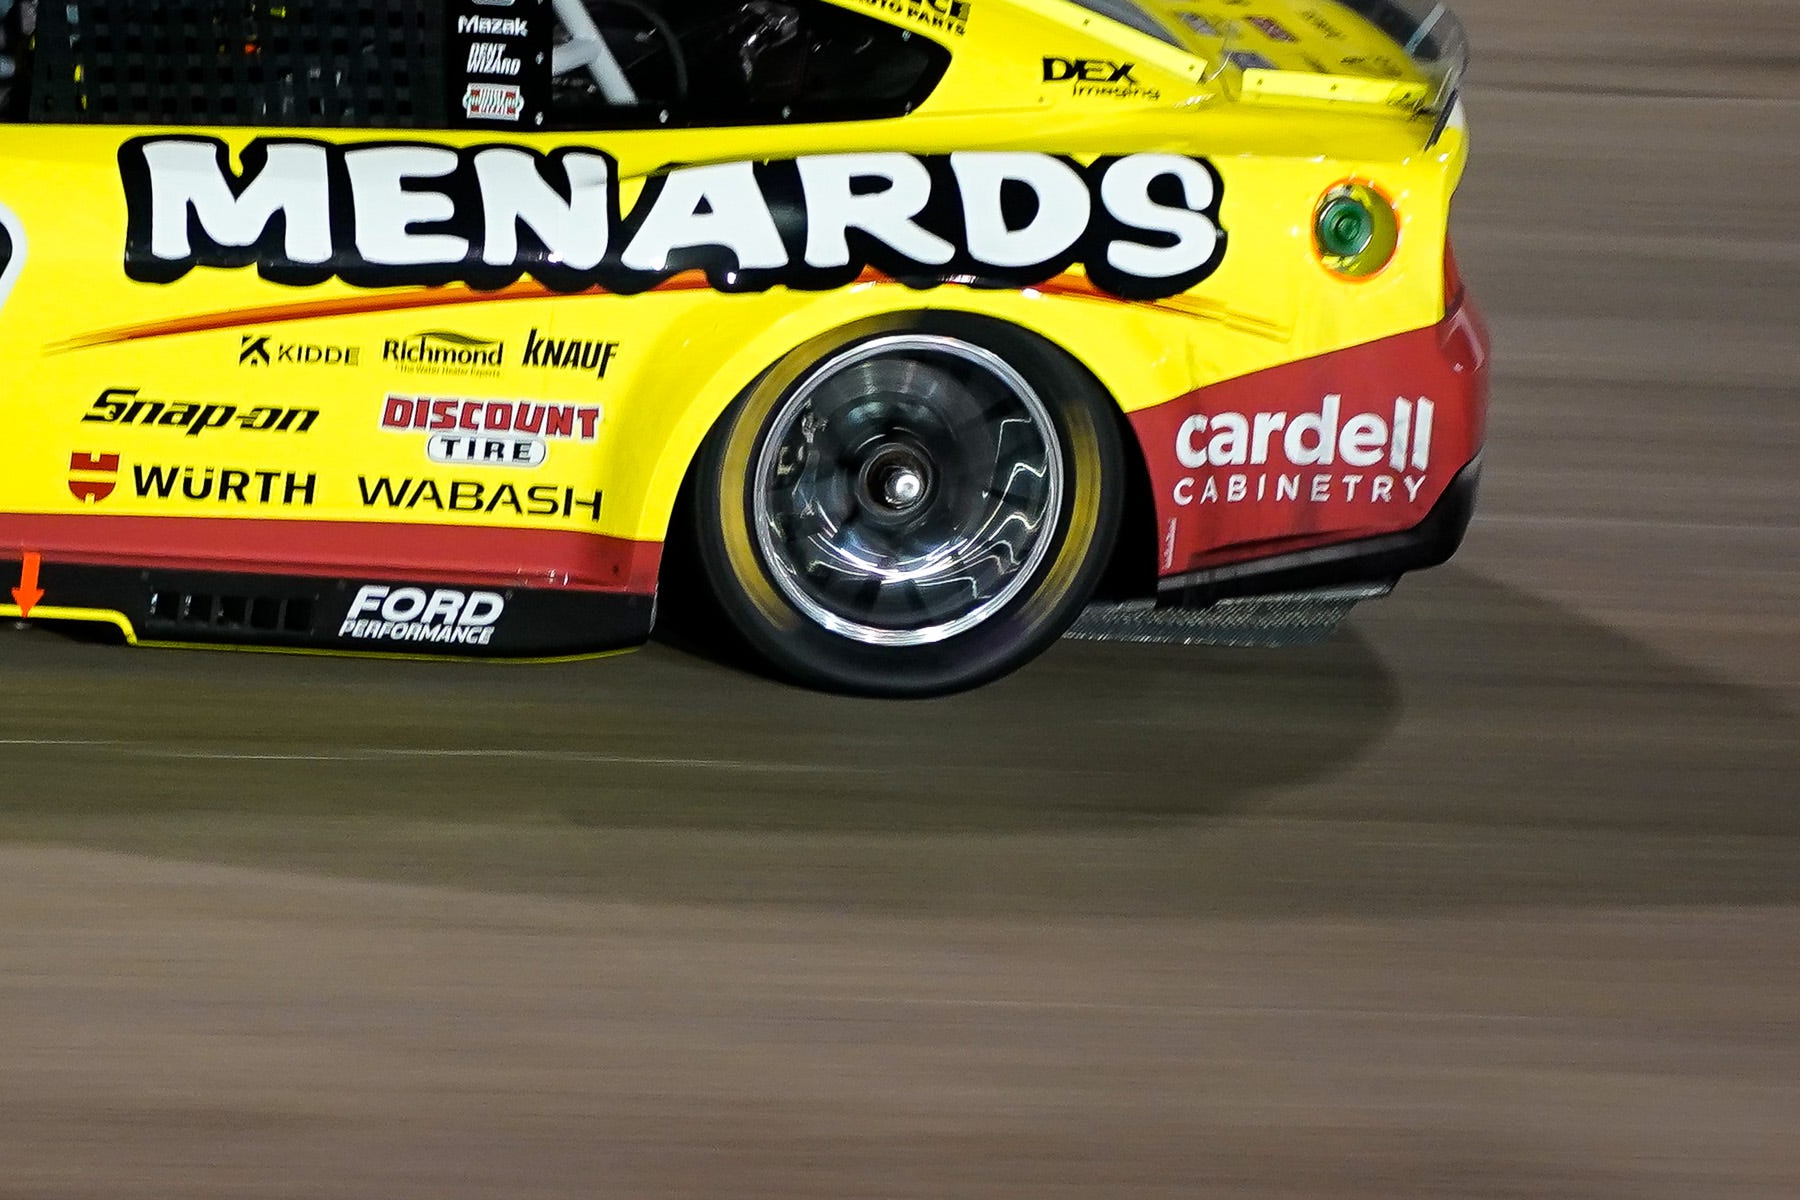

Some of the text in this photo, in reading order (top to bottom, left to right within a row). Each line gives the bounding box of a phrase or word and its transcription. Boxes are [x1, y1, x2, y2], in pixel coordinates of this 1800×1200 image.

[457, 14, 529, 37] Mazak
[1042, 56, 1140, 84] DEX
[130, 136, 1221, 288] MENARDS
[277, 343, 361, 367] KIDDE
[383, 335, 505, 366] Richmond
[522, 328, 620, 380] KNAUF
[81, 387, 320, 437] Snap-on
[381, 395, 600, 440] DISCOUNT
[440, 437, 532, 462] TIRE
[1175, 394, 1435, 473] cardell
[133, 463, 317, 506] WÜRTH
[357, 475, 603, 522] WABASH
[1172, 473, 1427, 506] CABINETRY
[346, 585, 505, 626] FORD
[338, 619, 495, 645] PERFORMANCE
